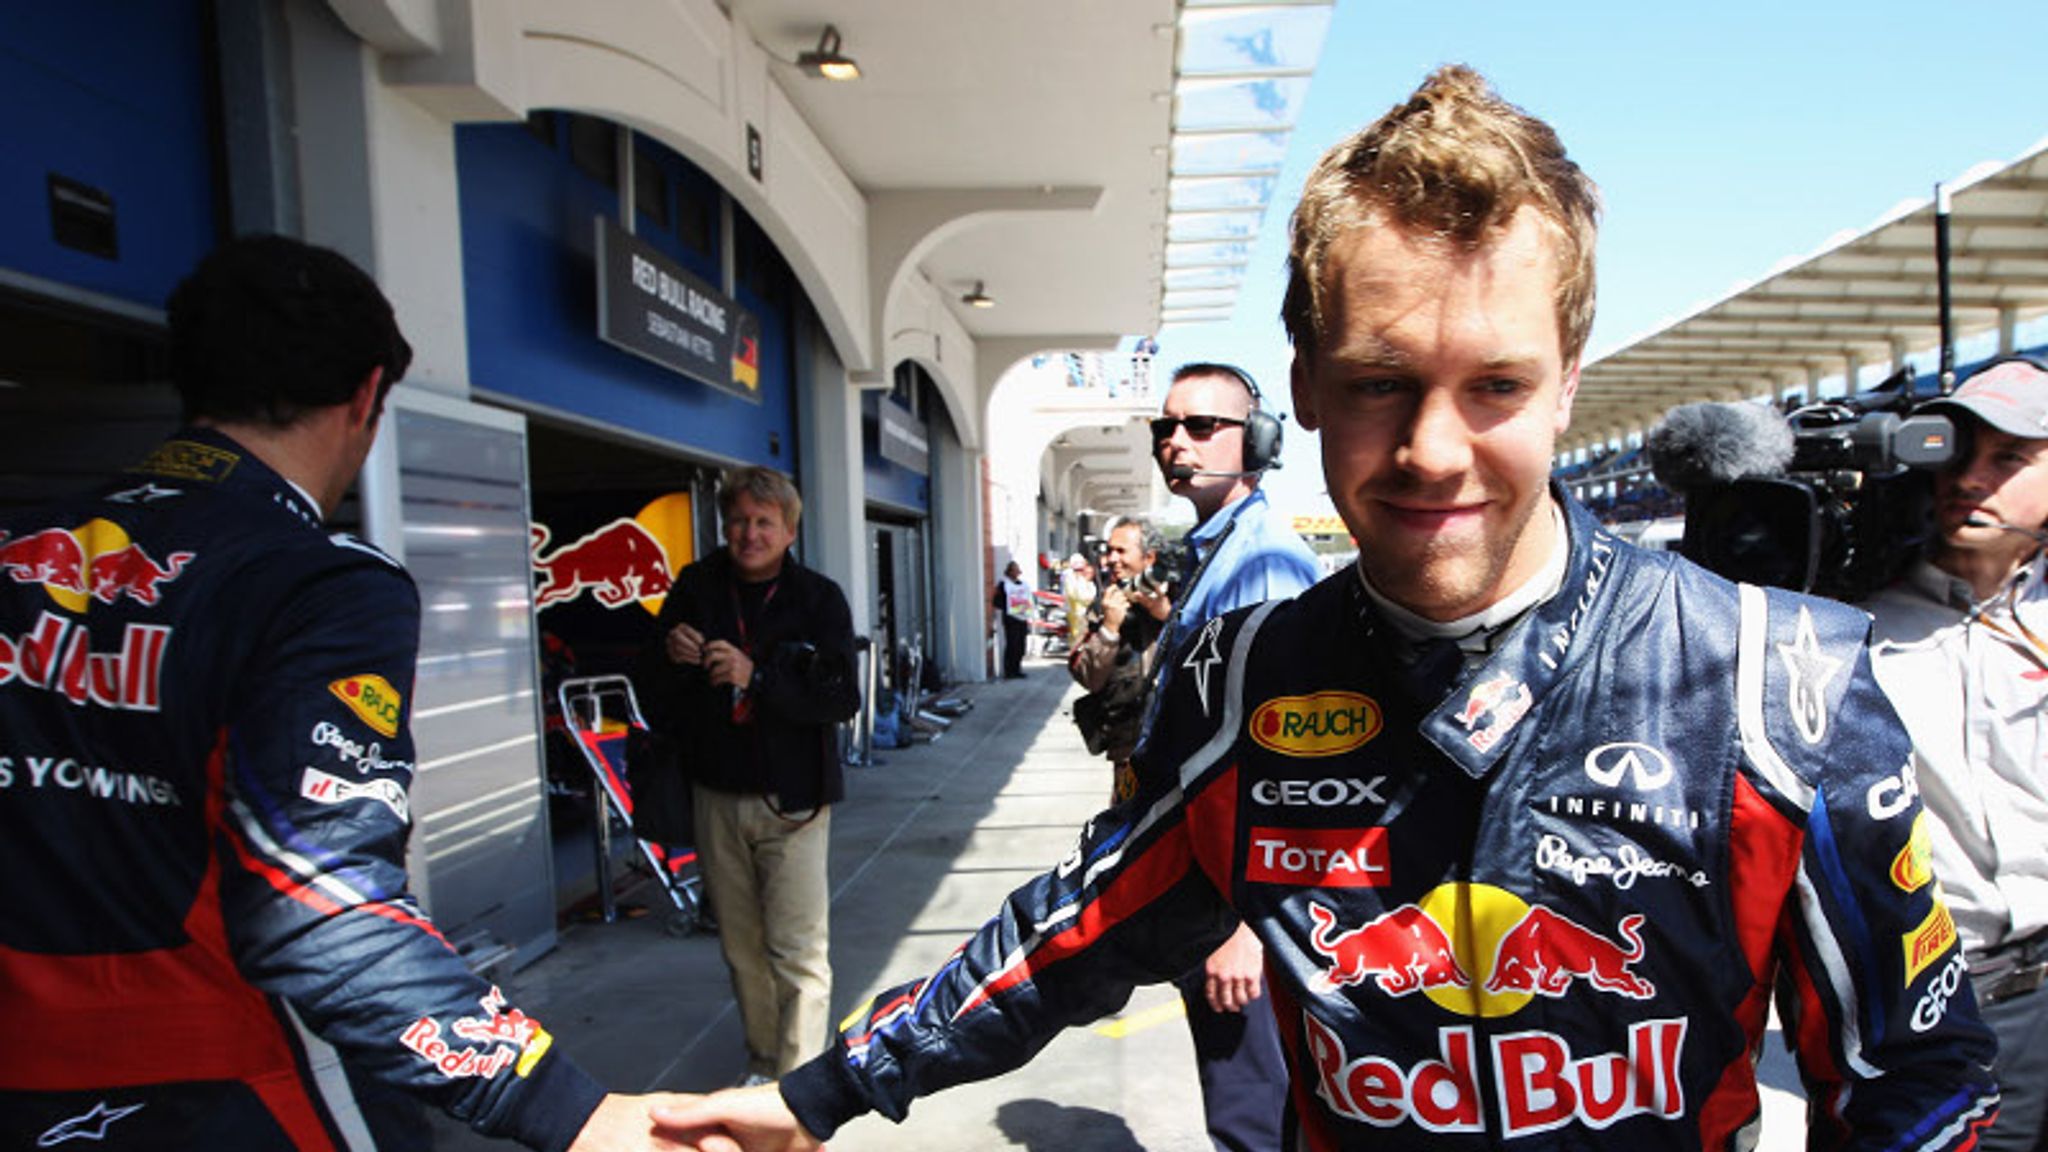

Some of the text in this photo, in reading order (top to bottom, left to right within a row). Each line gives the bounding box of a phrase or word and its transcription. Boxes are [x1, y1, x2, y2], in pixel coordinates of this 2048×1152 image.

[632, 254, 726, 334] RED BULL RACING
[0, 610, 71, 690] ed
[361, 684, 399, 724] RAUC
[1282, 707, 1367, 738] RAUCH
[26, 757, 84, 789] YO
[1251, 775, 1387, 806] GEOX
[1551, 795, 1699, 829] INFINITI
[1255, 839, 1384, 873] TOTAL
[1536, 834, 1711, 890] Pepe Jeans
[1909, 953, 1969, 1033] GEOX
[400, 1017, 475, 1078] Red
[1304, 1009, 1688, 1139] Red Bull
